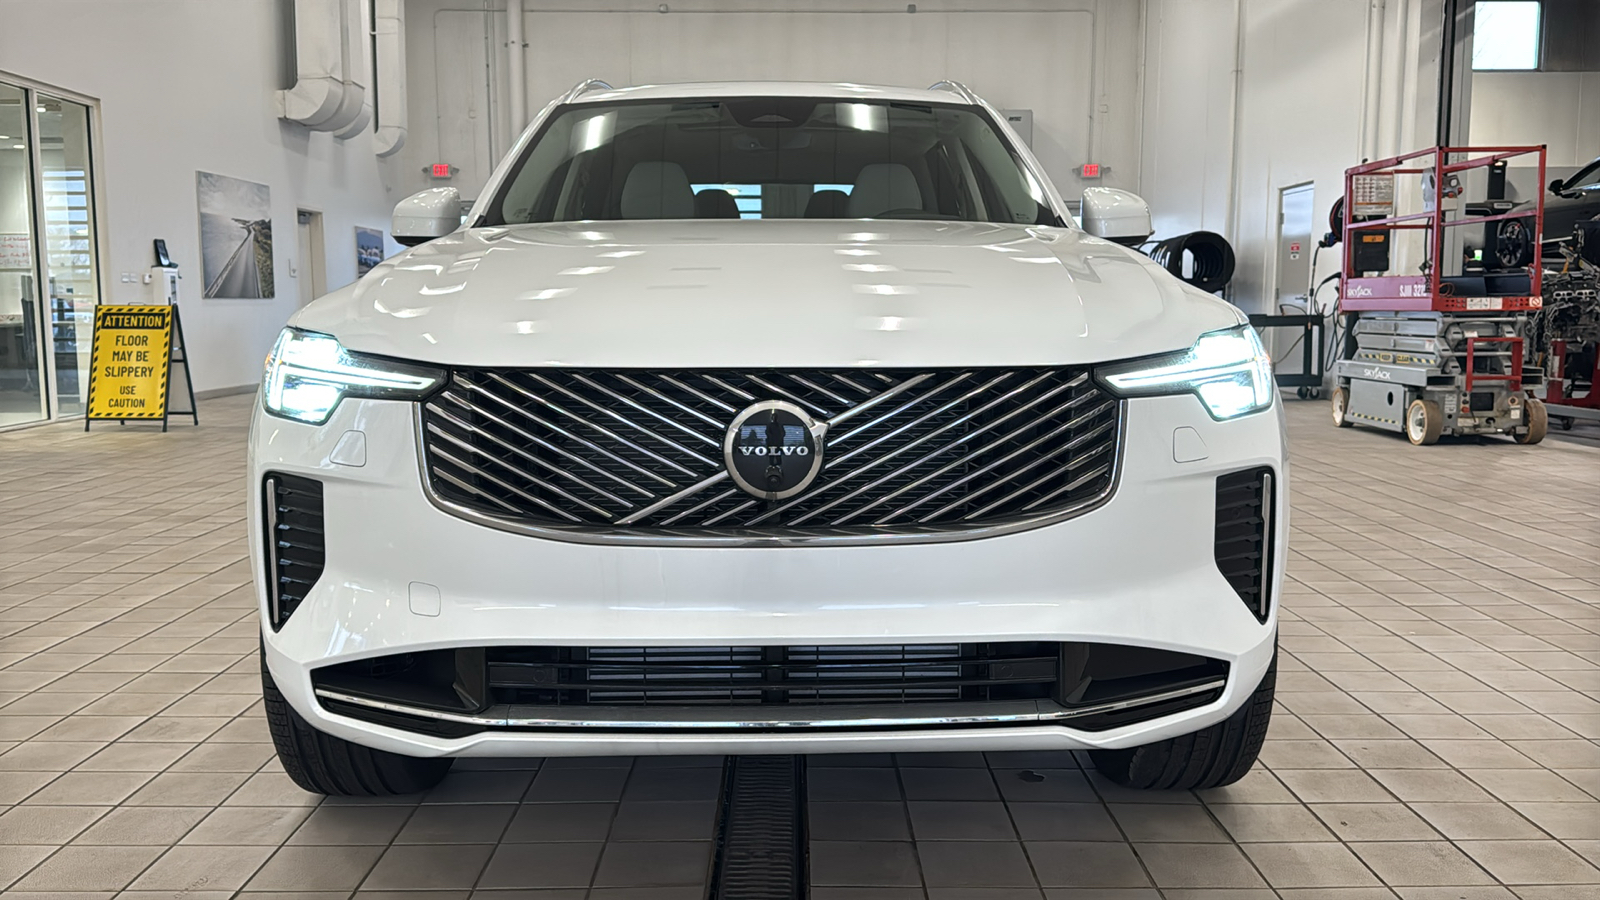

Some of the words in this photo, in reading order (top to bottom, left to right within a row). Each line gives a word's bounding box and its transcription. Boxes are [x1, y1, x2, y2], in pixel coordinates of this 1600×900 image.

[104, 315, 163, 327] ATTENTION
[115, 335, 149, 347] FLOOR
[112, 350, 133, 362] MAY
[136, 350, 149, 362] BE
[104, 366, 154, 378] SLIPPERY
[1363, 367, 1391, 379] SKYJACK
[119, 385, 136, 395] USE
[108, 398, 145, 408] CAUTION
[738, 445, 809, 456] VOLVO
